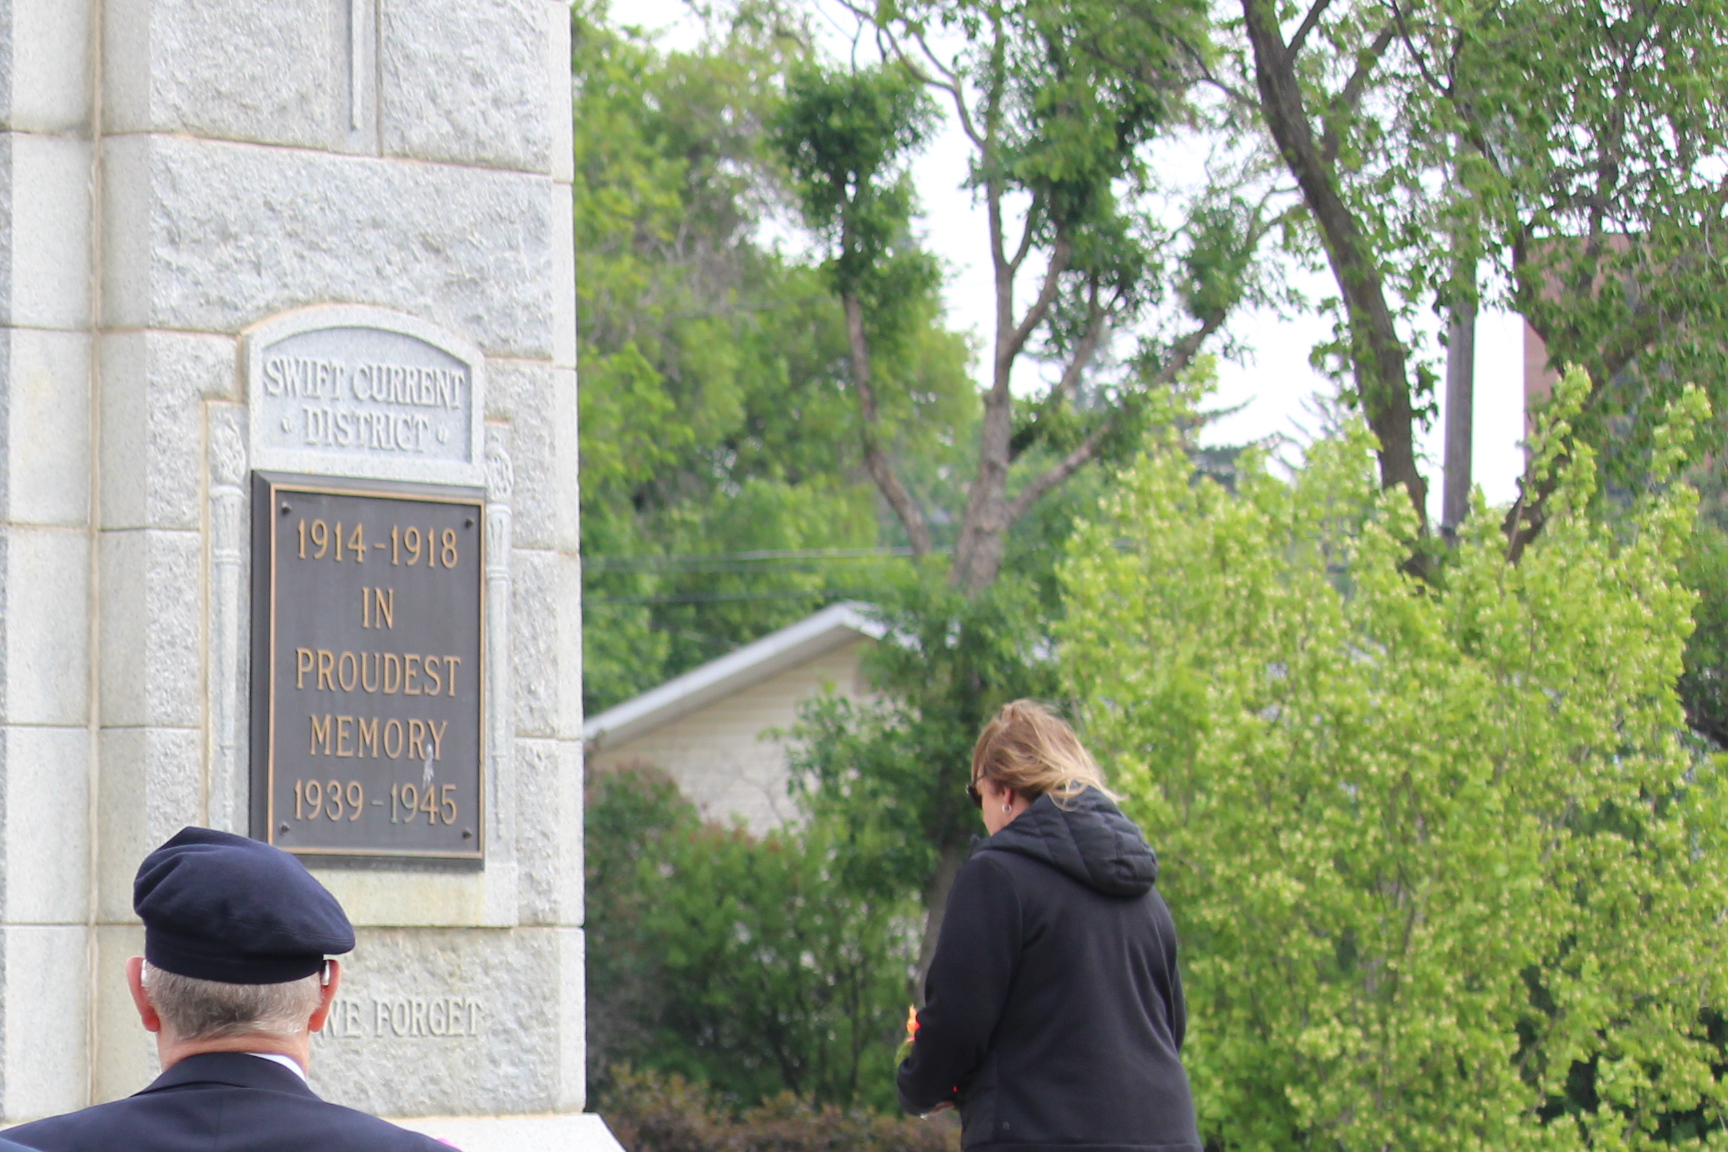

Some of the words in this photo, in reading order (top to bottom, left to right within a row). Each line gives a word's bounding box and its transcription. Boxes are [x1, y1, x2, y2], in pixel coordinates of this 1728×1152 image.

[264, 357, 345, 400] SWIFT
[352, 363, 465, 409] CURRENT
[303, 406, 428, 453] DISTRICT
[297, 518, 458, 569] 1914-1918
[362, 587, 394, 629] IN
[295, 647, 461, 697] PROUDEST
[309, 714, 448, 760] MEMORY
[294, 779, 458, 825] 1939-1945
[373, 998, 483, 1038] FORGET
